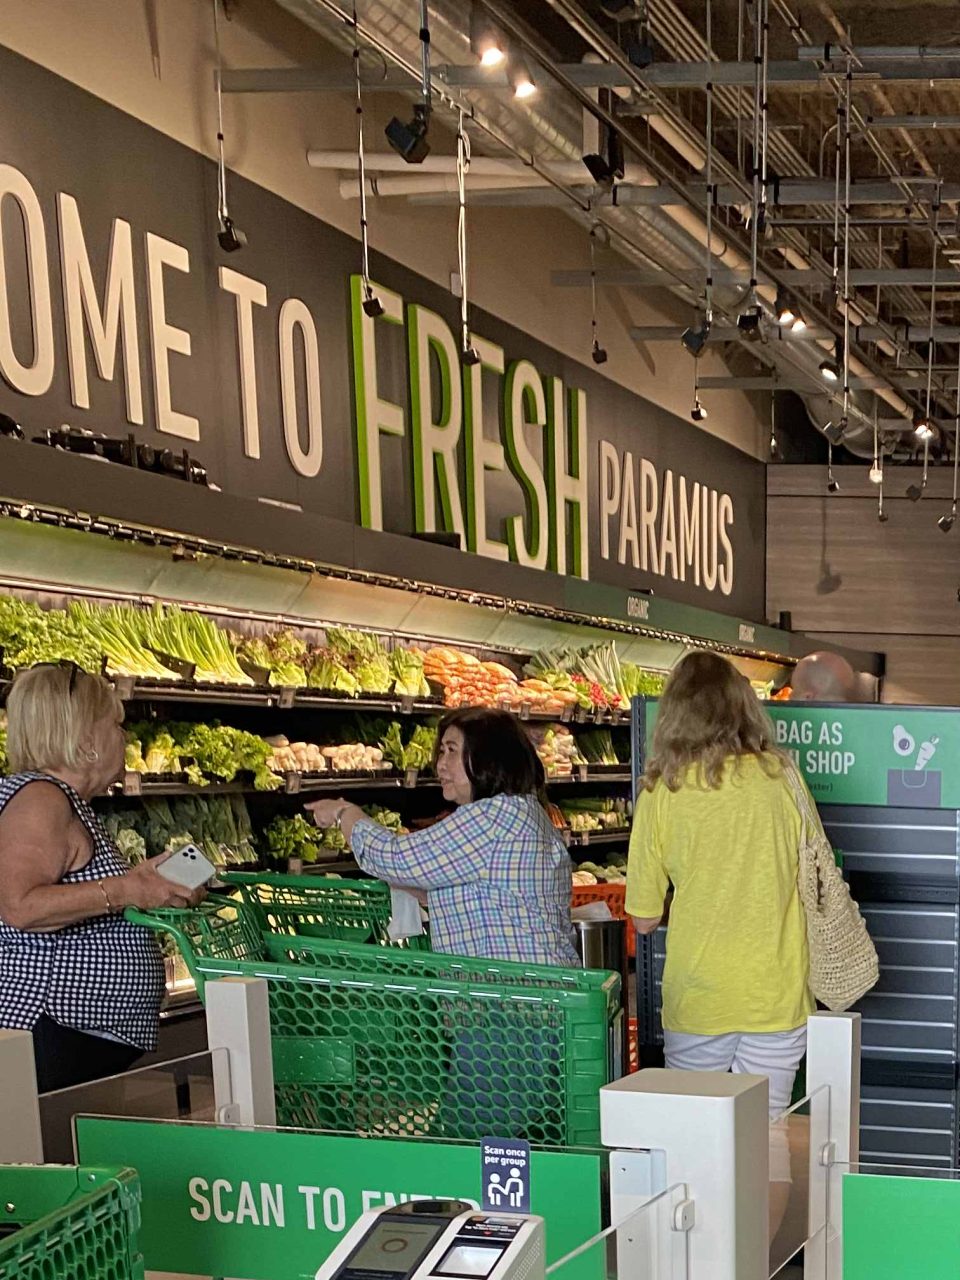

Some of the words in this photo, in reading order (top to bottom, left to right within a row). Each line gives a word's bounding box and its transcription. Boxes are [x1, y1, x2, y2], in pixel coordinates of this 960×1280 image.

[219, 266, 323, 478] TO
[350, 274, 589, 581] FRESH
[599, 439, 734, 595] PARAMUS
[776, 719, 813, 744] BAG
[818, 721, 843, 746] AS
[805, 750, 856, 775] SHOP
[484, 1145, 505, 1156] Scan
[505, 1148, 526, 1158] once
[484, 1155, 500, 1165] per
[500, 1157, 526, 1168] group
[188, 1176, 285, 1228] SCAN
[298, 1185, 346, 1232] TO
